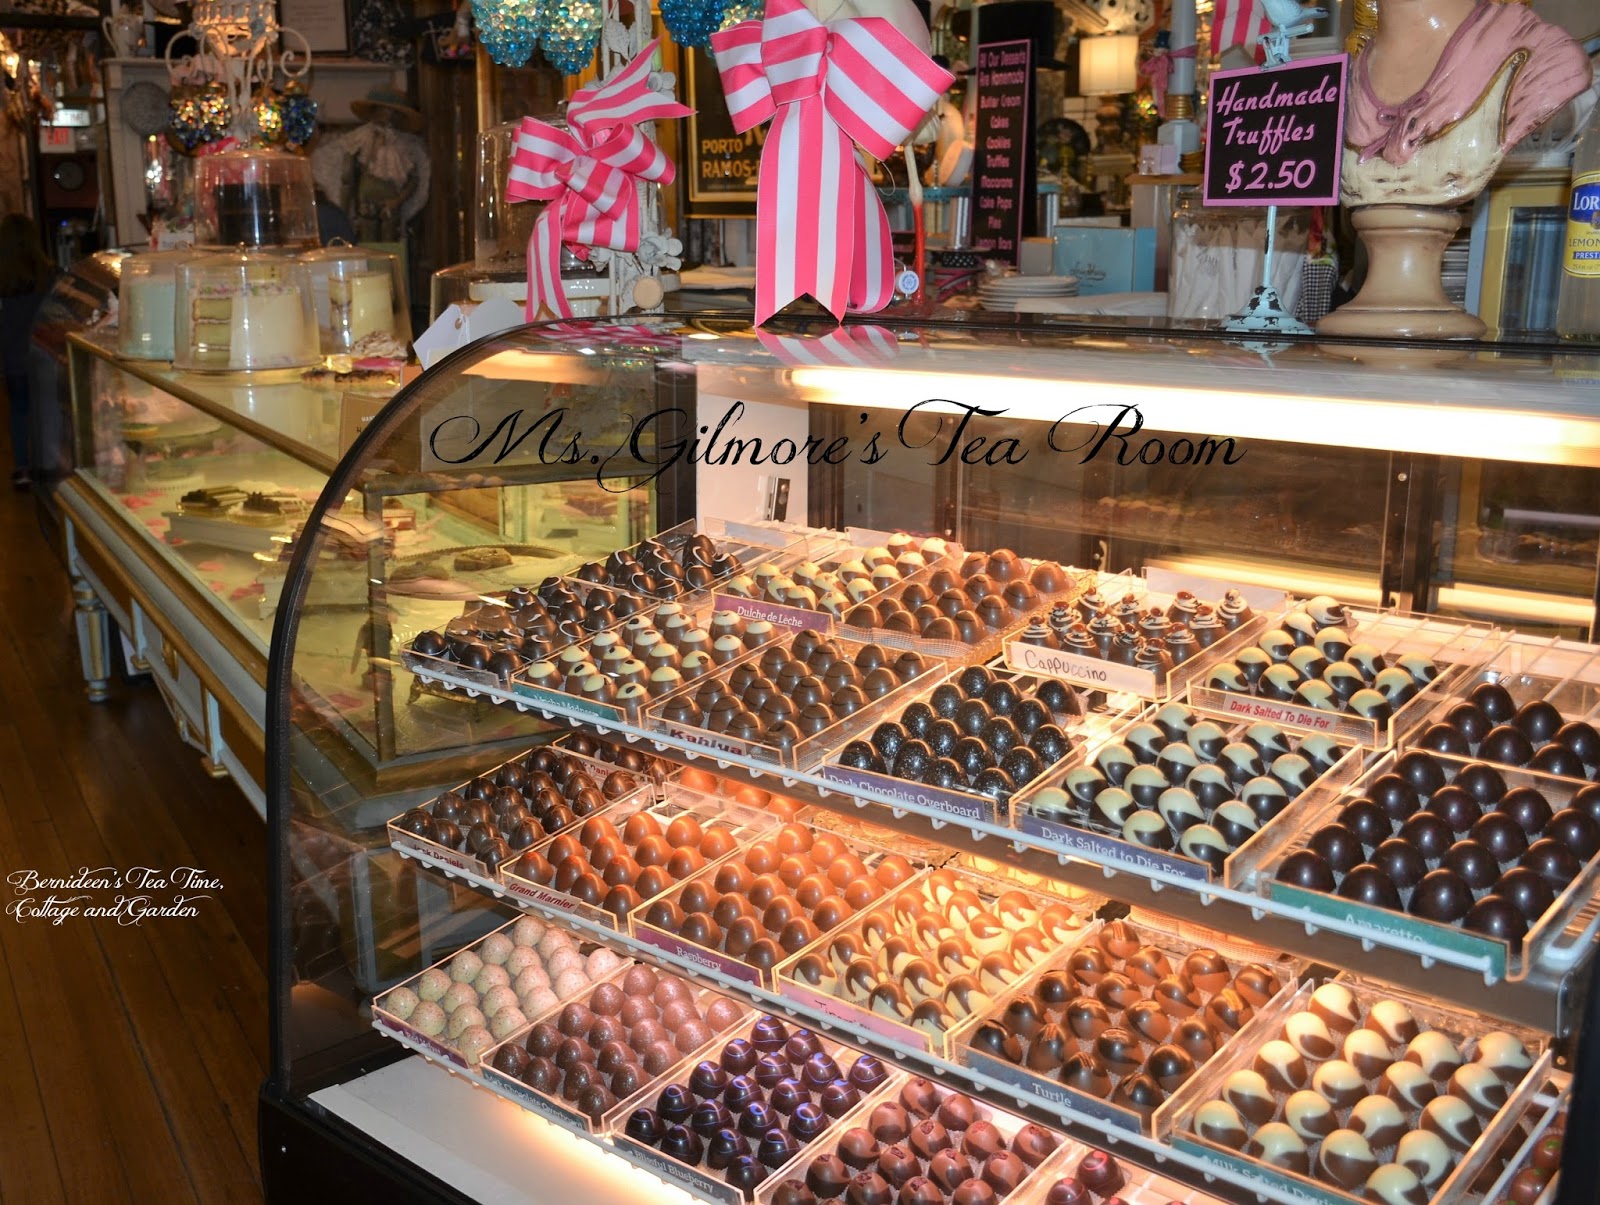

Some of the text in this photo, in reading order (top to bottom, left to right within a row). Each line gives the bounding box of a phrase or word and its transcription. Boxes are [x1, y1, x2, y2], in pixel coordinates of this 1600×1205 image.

[991, 71, 1025, 86] Homemade
[980, 94, 1021, 109] Butter Cream
[1216, 75, 1337, 116] Handmade
[702, 138, 743, 154] PORTO
[986, 136, 1011, 149] Cookies
[1222, 115, 1315, 155] Truffles
[986, 153, 1010, 168] Truffles
[737, 606, 803, 628] Dulche de Leche
[1024, 649, 1107, 681] Cappuccino
[1230, 701, 1330, 730] Dark Salted To Die For
[670, 729, 742, 756] Kahlua
[859, 781, 915, 804] Chocolate
[917, 795, 980, 820] Overboard
[433, 851, 464, 870] Daniels
[1041, 827, 1073, 846] Dark
[1076, 837, 1116, 858] Salted
[1136, 855, 1160, 871] Die
[509, 883, 576, 909] Grand Marnier
[676, 946, 721, 970] Raspberry
[1032, 1082, 1072, 1107] Turtle
[667, 1164, 714, 1193] Blueberry
